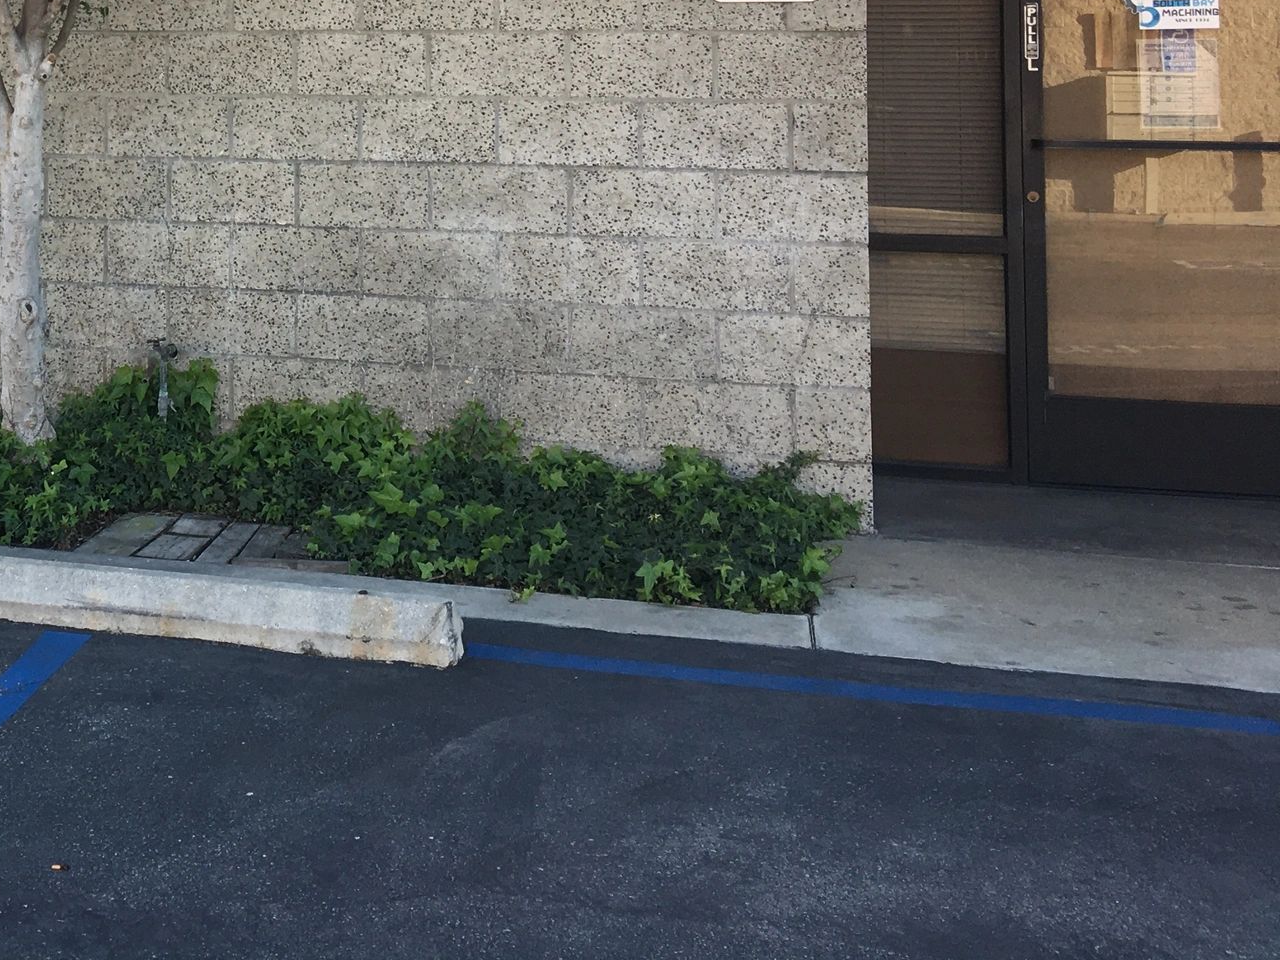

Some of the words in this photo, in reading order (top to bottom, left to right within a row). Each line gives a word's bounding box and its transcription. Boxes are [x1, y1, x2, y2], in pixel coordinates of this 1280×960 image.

[1193, 0, 1215, 7] BAY
[1162, 8, 1219, 16] MACHINING
[1026, 7, 1037, 44] PULL
